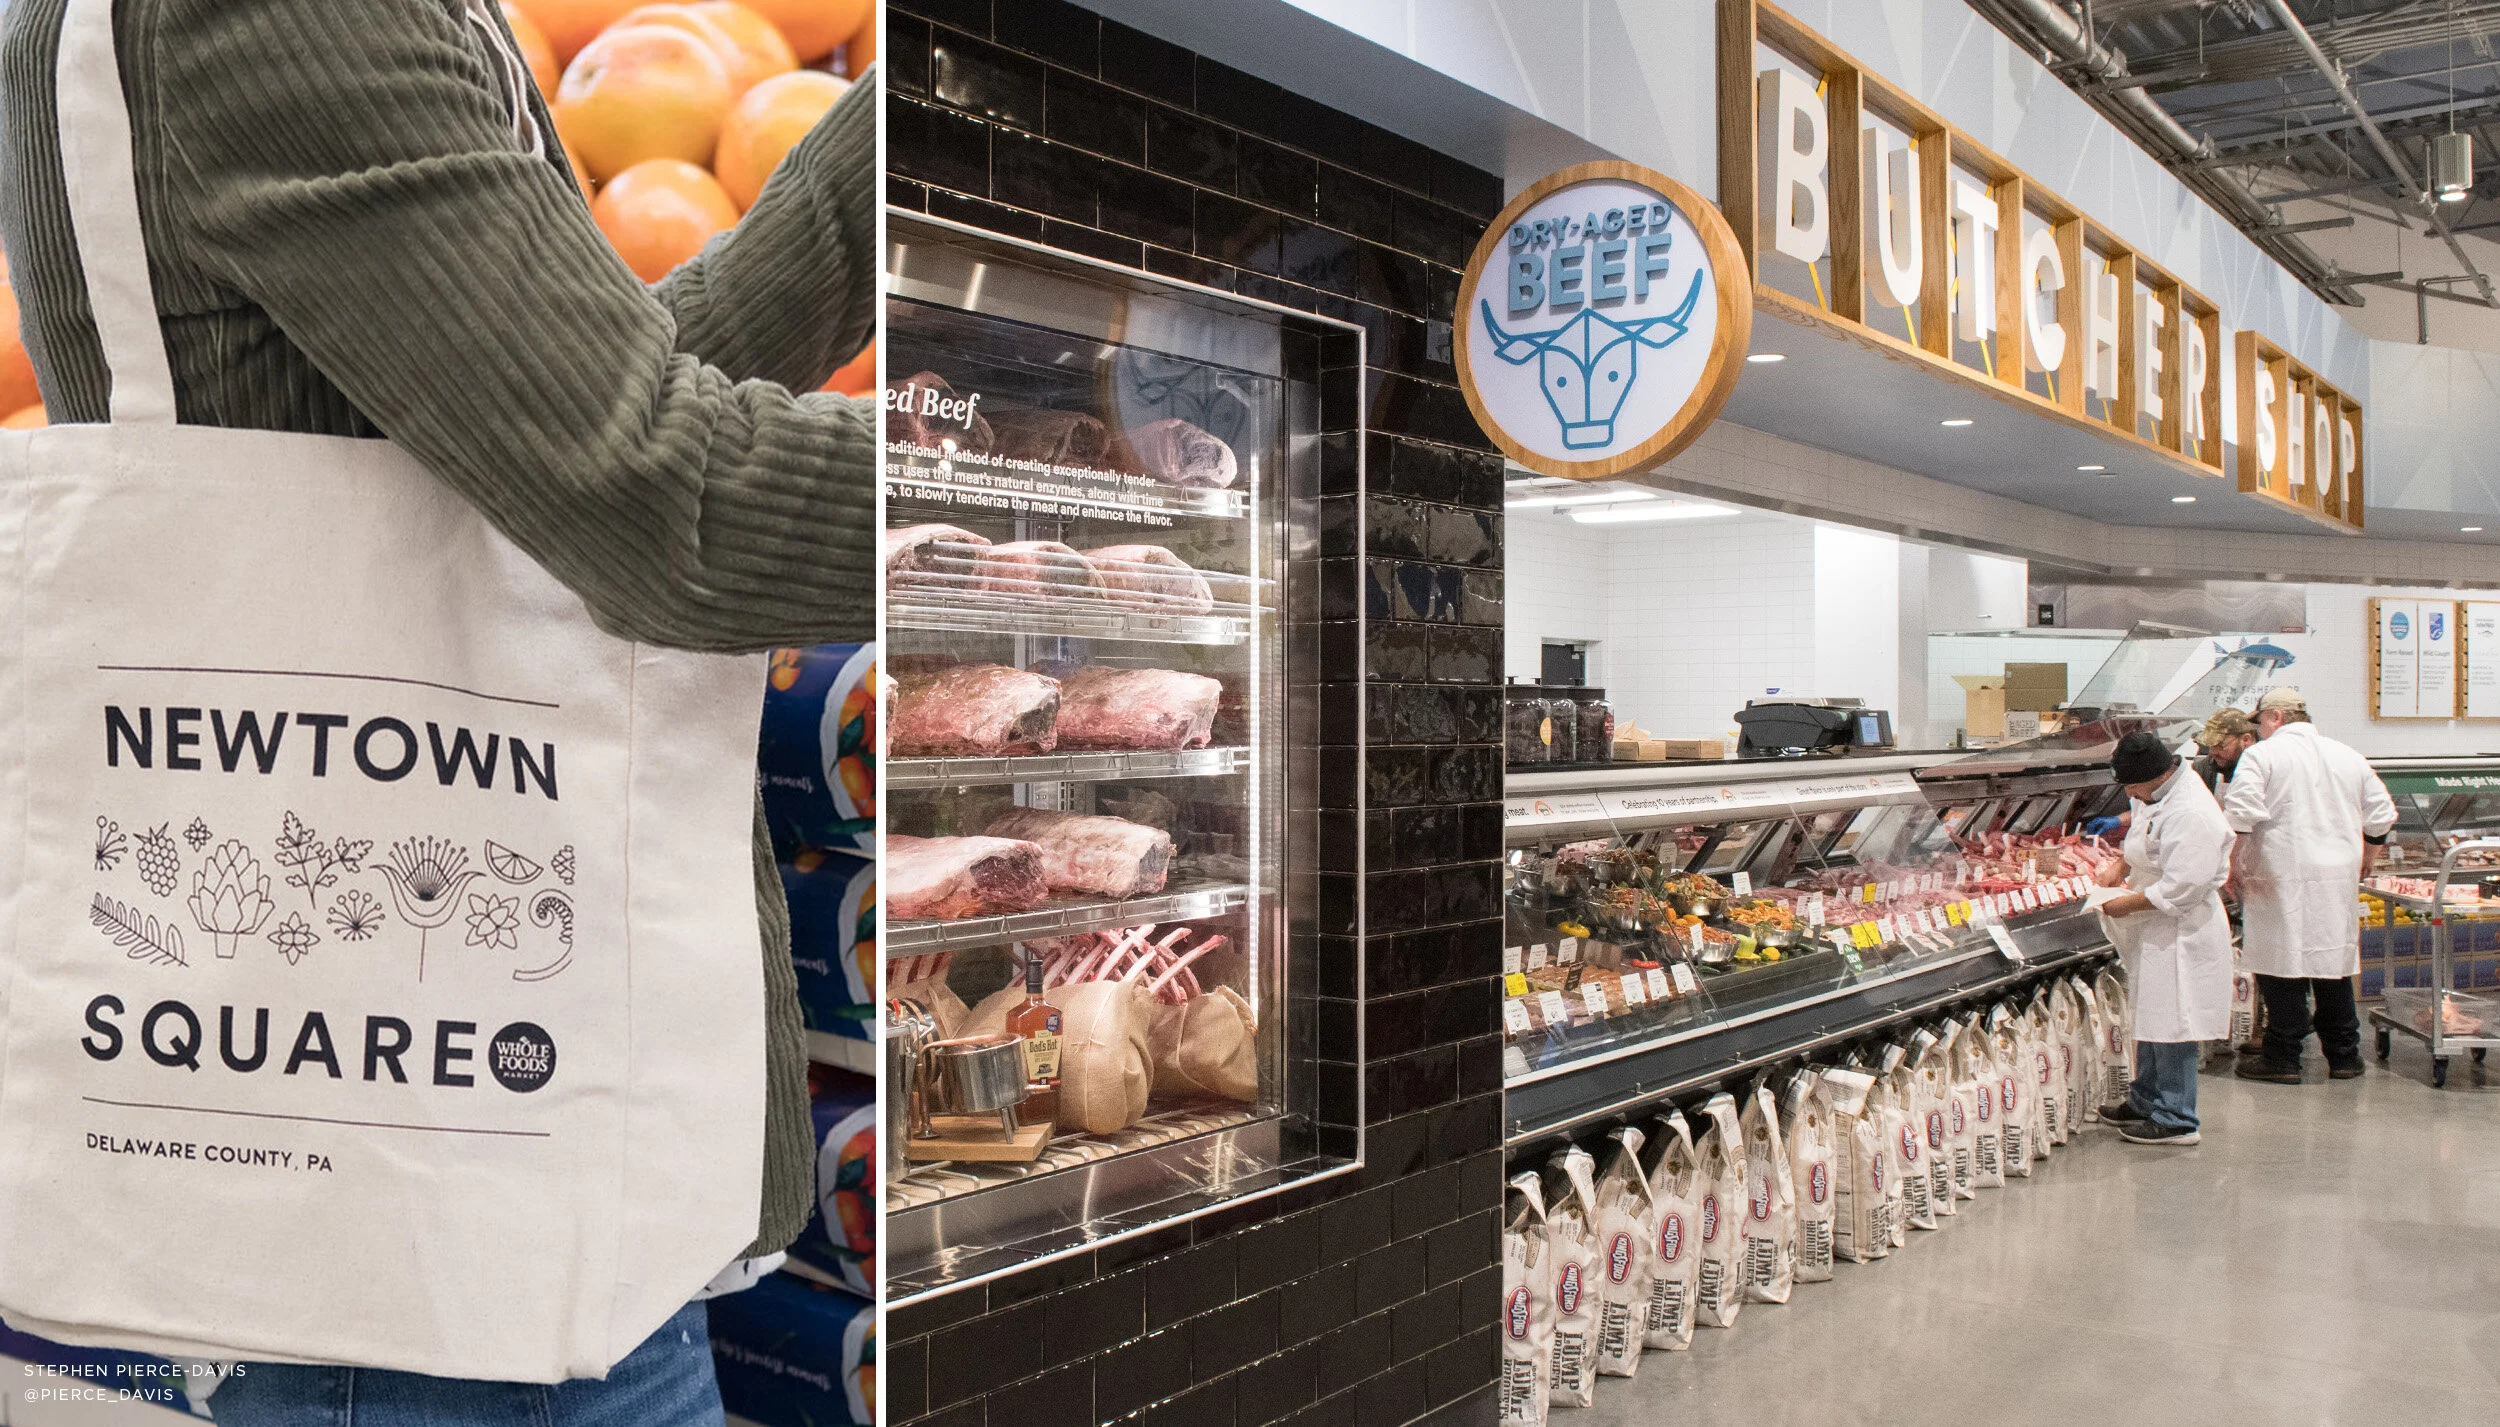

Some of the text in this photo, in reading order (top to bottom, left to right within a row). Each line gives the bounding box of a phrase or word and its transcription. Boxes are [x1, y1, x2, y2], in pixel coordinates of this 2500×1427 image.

[1508, 202, 1672, 249] DRY-AGED
[1508, 233, 1672, 313] BEEF
[1758, 68, 2355, 502] BUTCHER SHOP
[920, 387, 980, 430] Beef
[903, 466, 930, 479] uses
[933, 467, 952, 481] the
[955, 472, 991, 486] meat's
[995, 477, 1033, 491] natural
[1036, 481, 1085, 499] enzymes,
[1088, 486, 1119, 503] along
[1118, 490, 1140, 504] with
[1142, 493, 1163, 507] time
[945, 448, 989, 465] method
[991, 454, 1004, 467] of
[1006, 458, 1051, 476] creating
[1053, 465, 1122, 485] exceptionally
[1124, 473, 1156, 487] tender
[900, 484, 913, 497] to
[915, 484, 953, 505] slowly
[956, 490, 1009, 508] tenderize
[1012, 497, 1029, 510] the
[1031, 501, 1058, 514] meat
[1060, 503, 1079, 516] and
[1082, 507, 1124, 521] enhance
[1126, 510, 1141, 524] the
[1144, 513, 1173, 527] flavor.
[104, 706, 559, 801] NEWTOWN
[81, 994, 477, 1087] SQUARE
[496, 1040, 551, 1058] WHOLE
[498, 1055, 548, 1072] FOODS
[86, 1132, 332, 1173] DELAWARE COUNTY, PA
[1611, 1237, 1628, 1280] KINGSFORD
[1664, 1217, 1681, 1259] KINGSFORD
[1700, 1258, 1721, 1311] LUMP
[1755, 1237, 1774, 1287] LUMP
[1562, 1266, 1580, 1311] KINGSFORD
[1649, 1278, 1664, 1331] BRIQUETS
[1662, 1279, 1682, 1334] LUMP
[1511, 1290, 1529, 1336] KINGSFORD
[1604, 1301, 1628, 1359] LUMP
[1561, 1332, 1583, 1391] LUMP
